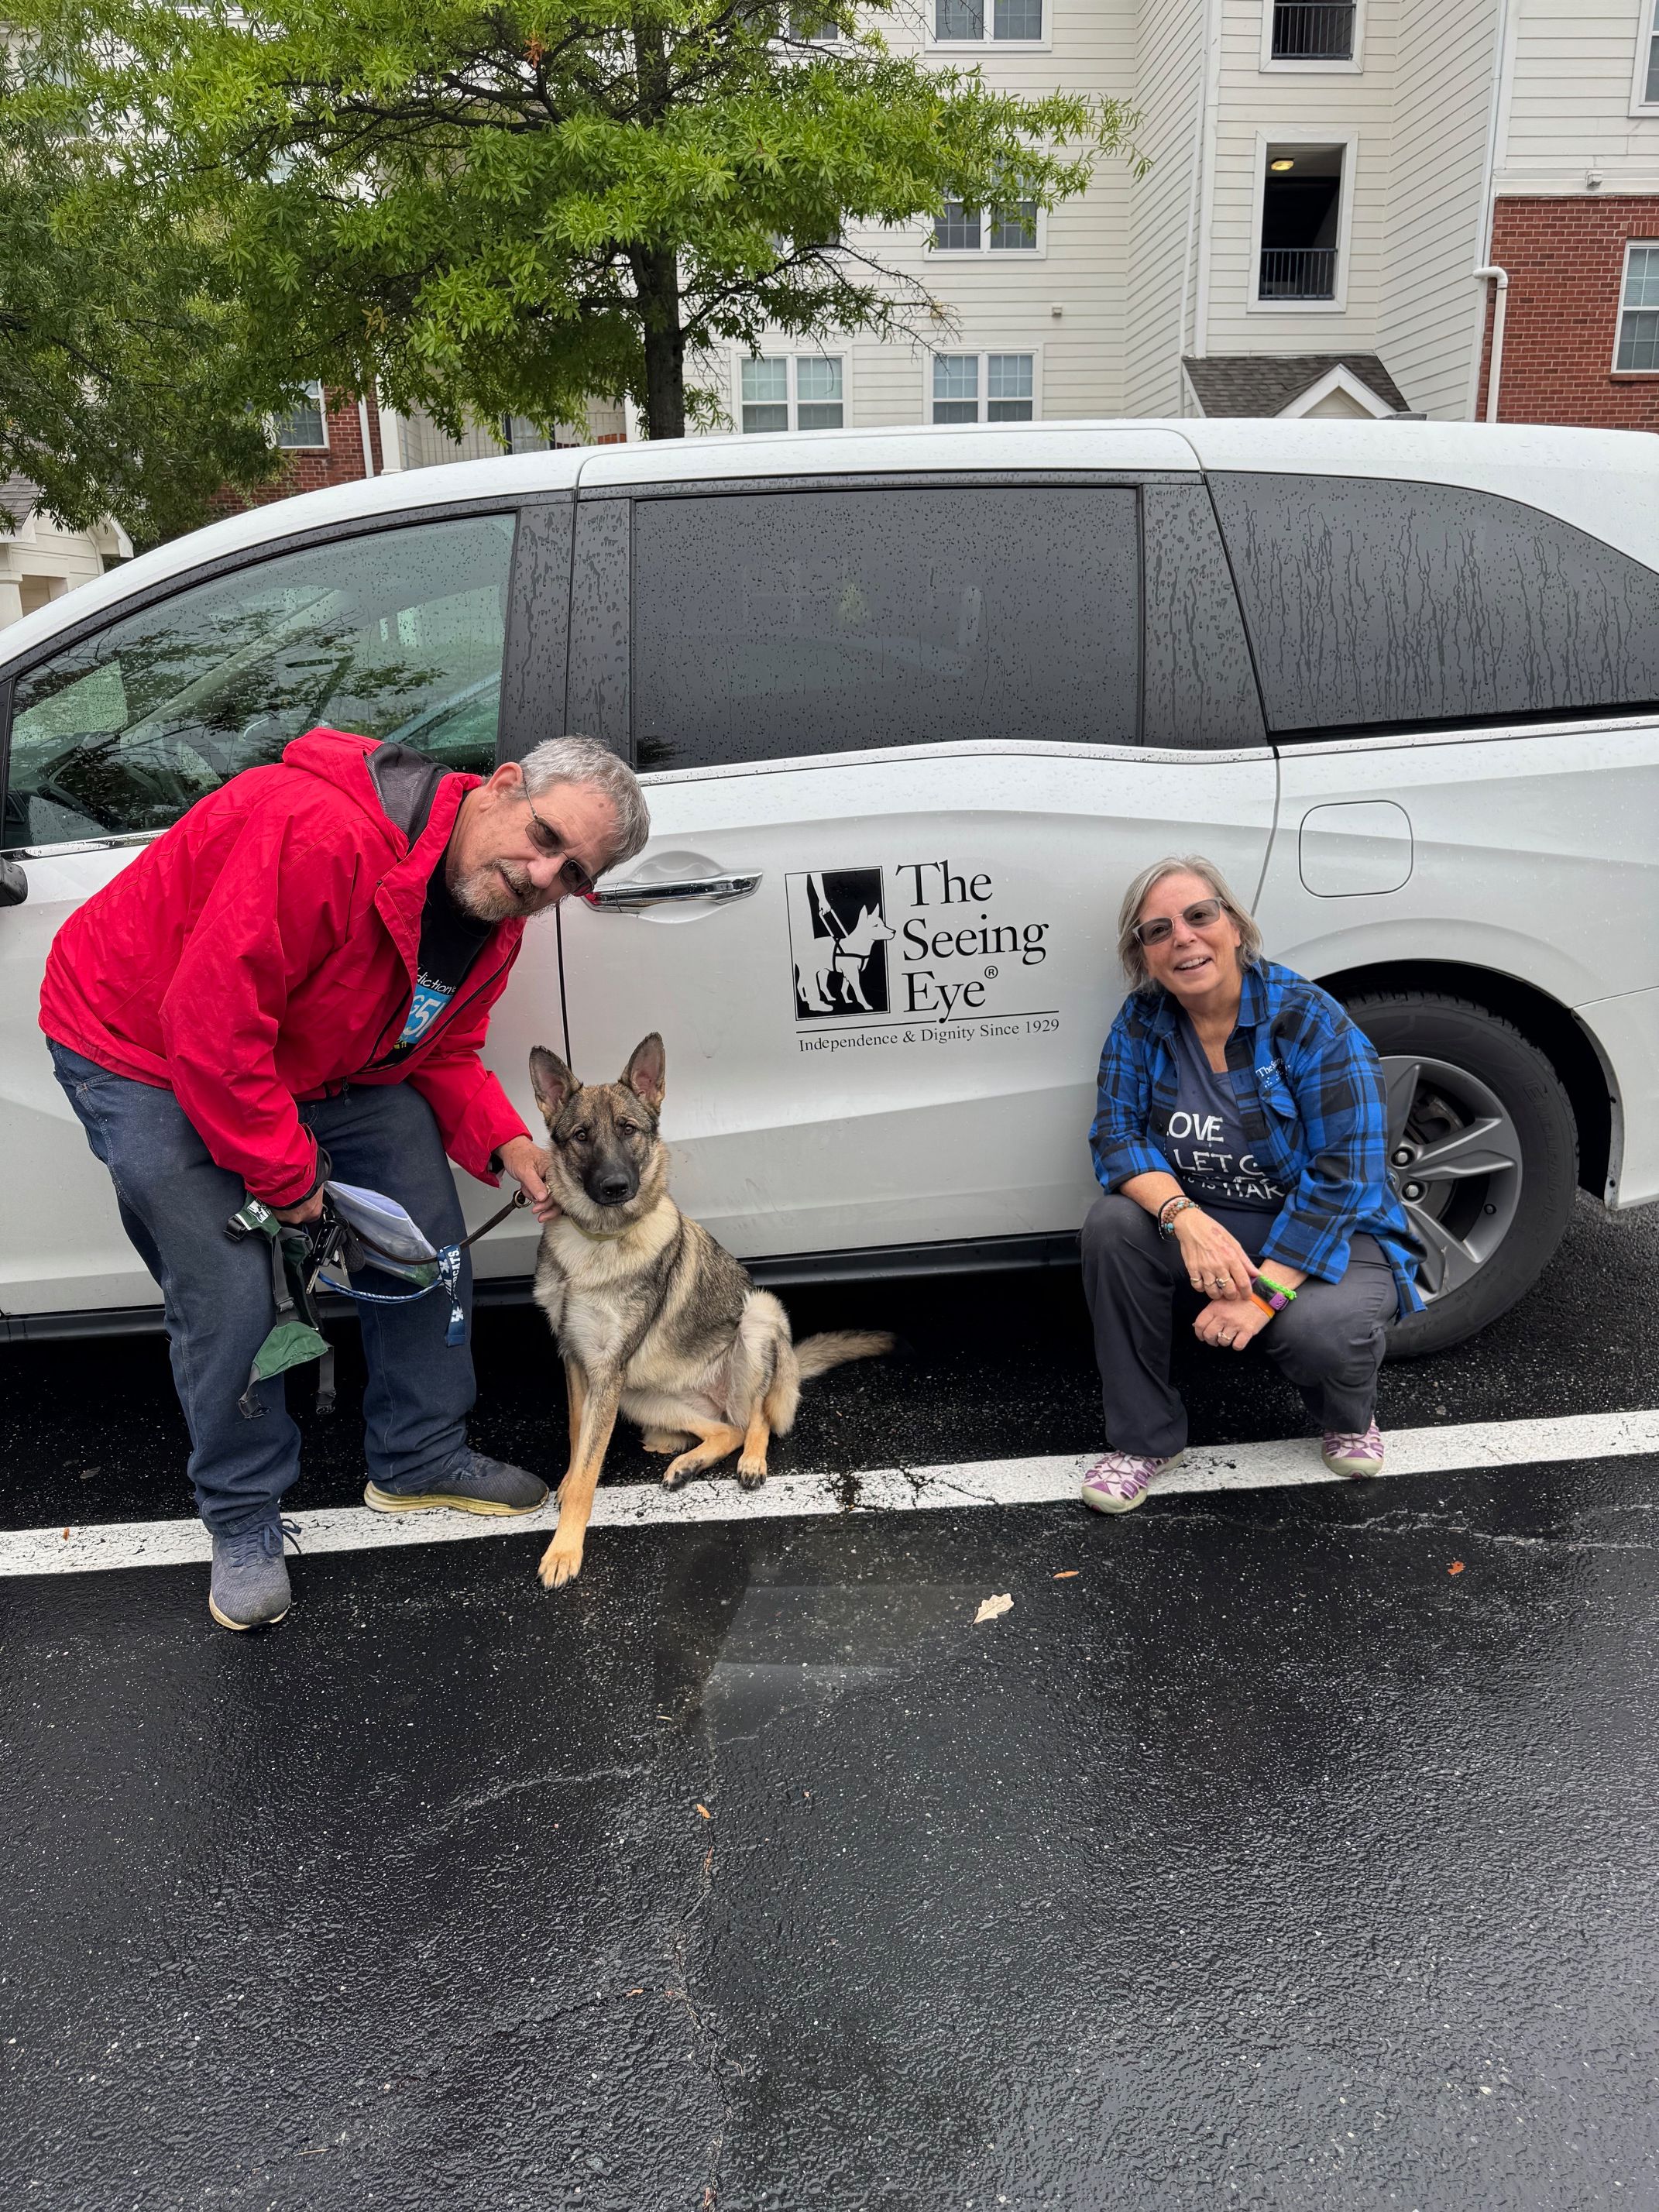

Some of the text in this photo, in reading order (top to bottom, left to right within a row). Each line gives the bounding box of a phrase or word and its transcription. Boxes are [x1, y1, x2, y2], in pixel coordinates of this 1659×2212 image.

[895, 860, 993, 907] The
[903, 914, 1049, 965] Seeing
[799, 1018, 1060, 1052] Independence & Dignity Since 1929
[1166, 1111, 1224, 1142] OVE
[1173, 1149, 1233, 1173] LET
